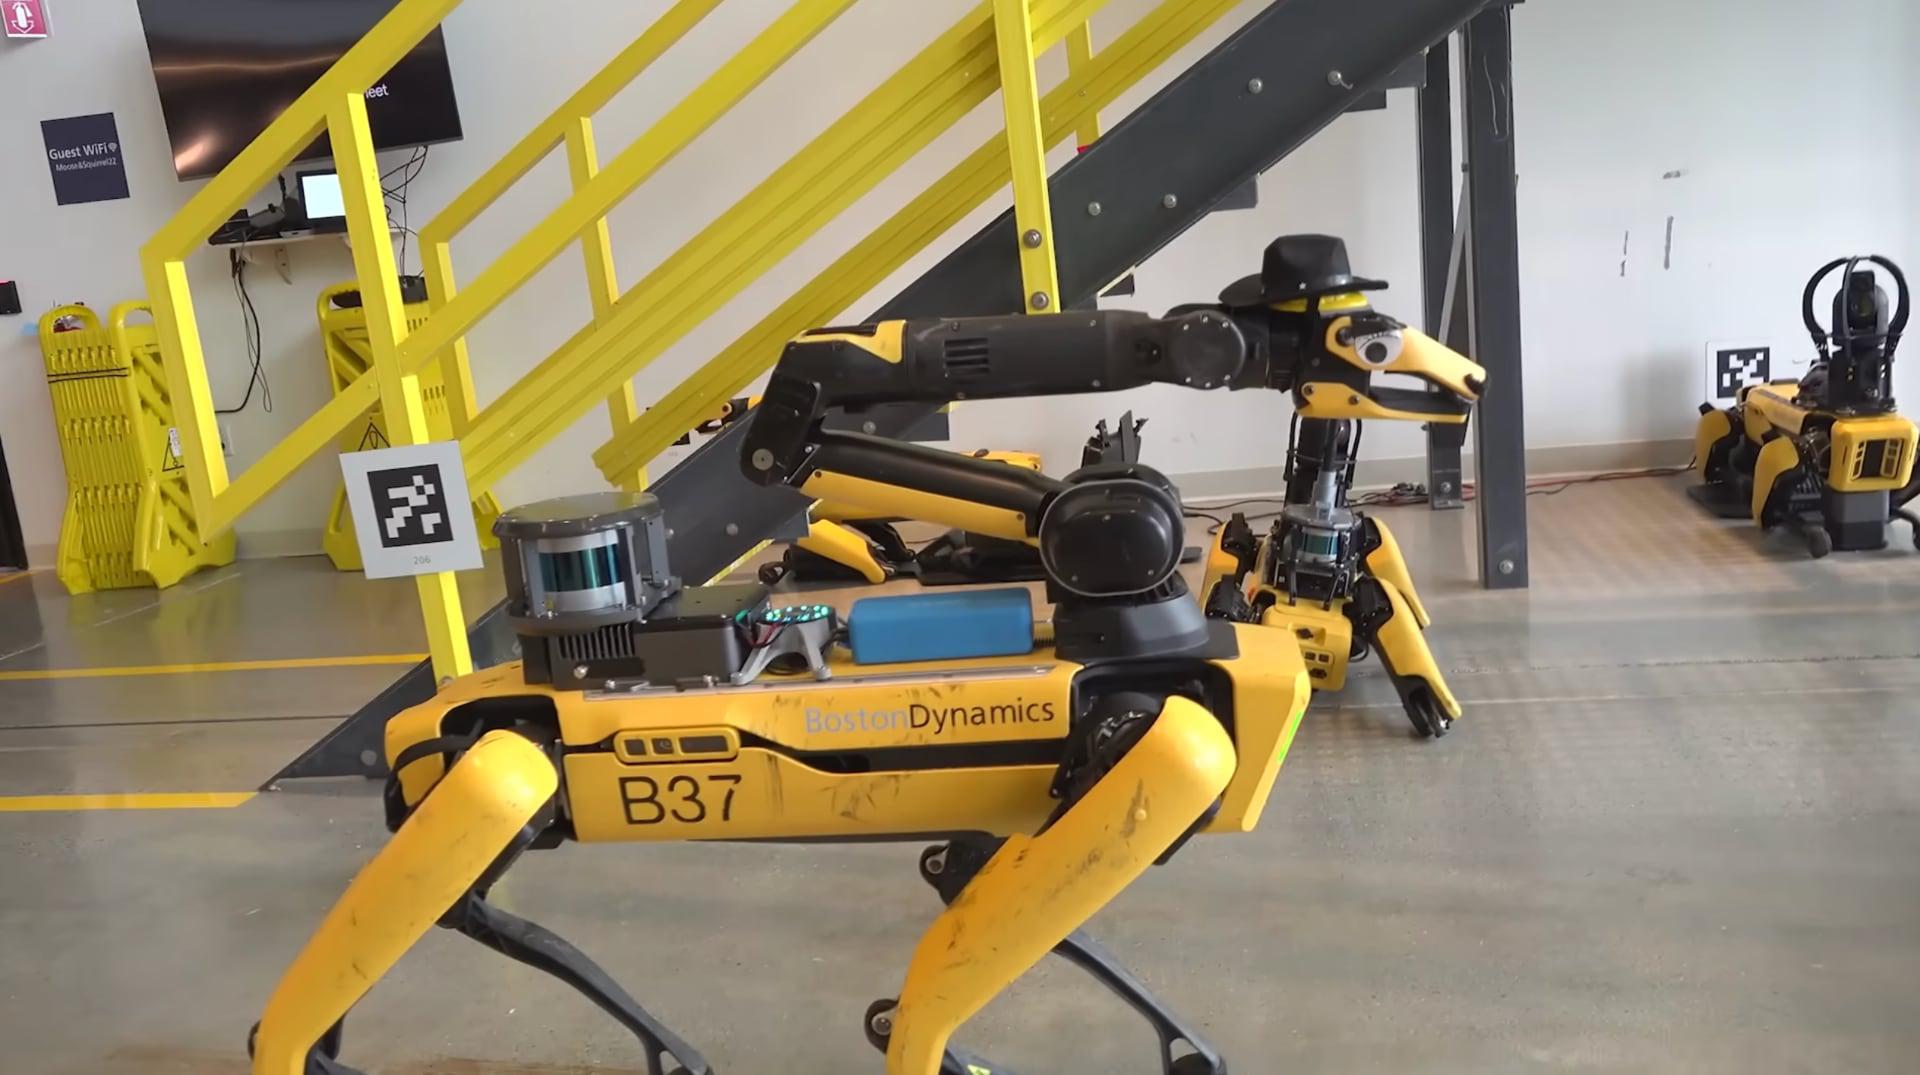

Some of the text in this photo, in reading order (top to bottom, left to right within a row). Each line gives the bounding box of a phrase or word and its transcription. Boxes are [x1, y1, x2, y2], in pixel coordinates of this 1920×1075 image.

[365, 83, 389, 99] eet
[49, 142, 108, 160] Guest WiFi
[413, 555, 431, 565] 206
[618, 774, 742, 825] B37
